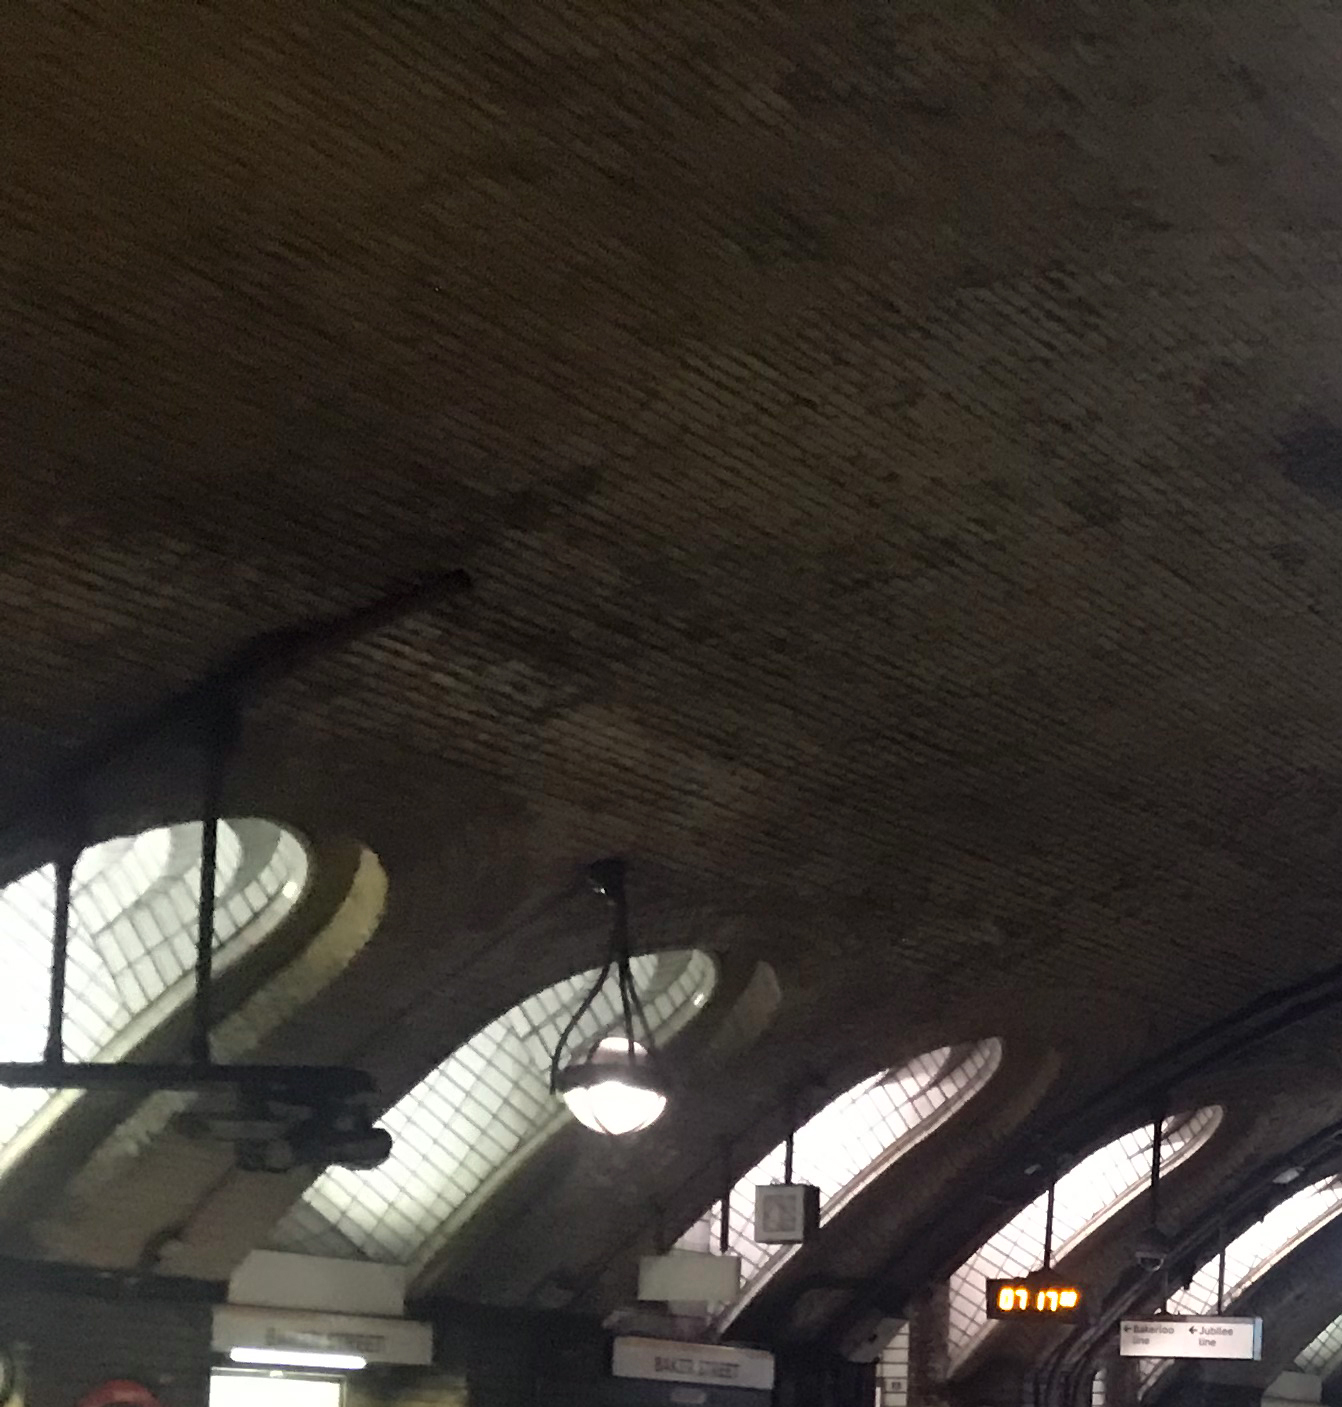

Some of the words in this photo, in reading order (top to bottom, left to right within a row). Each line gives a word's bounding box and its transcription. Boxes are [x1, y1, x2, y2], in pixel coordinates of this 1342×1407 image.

[1133, 1324, 1175, 1335] Bakerloo
[1200, 1326, 1233, 1336] Jubilee
[1133, 1336, 1150, 1345] line
[1199, 1338, 1216, 1347] line
